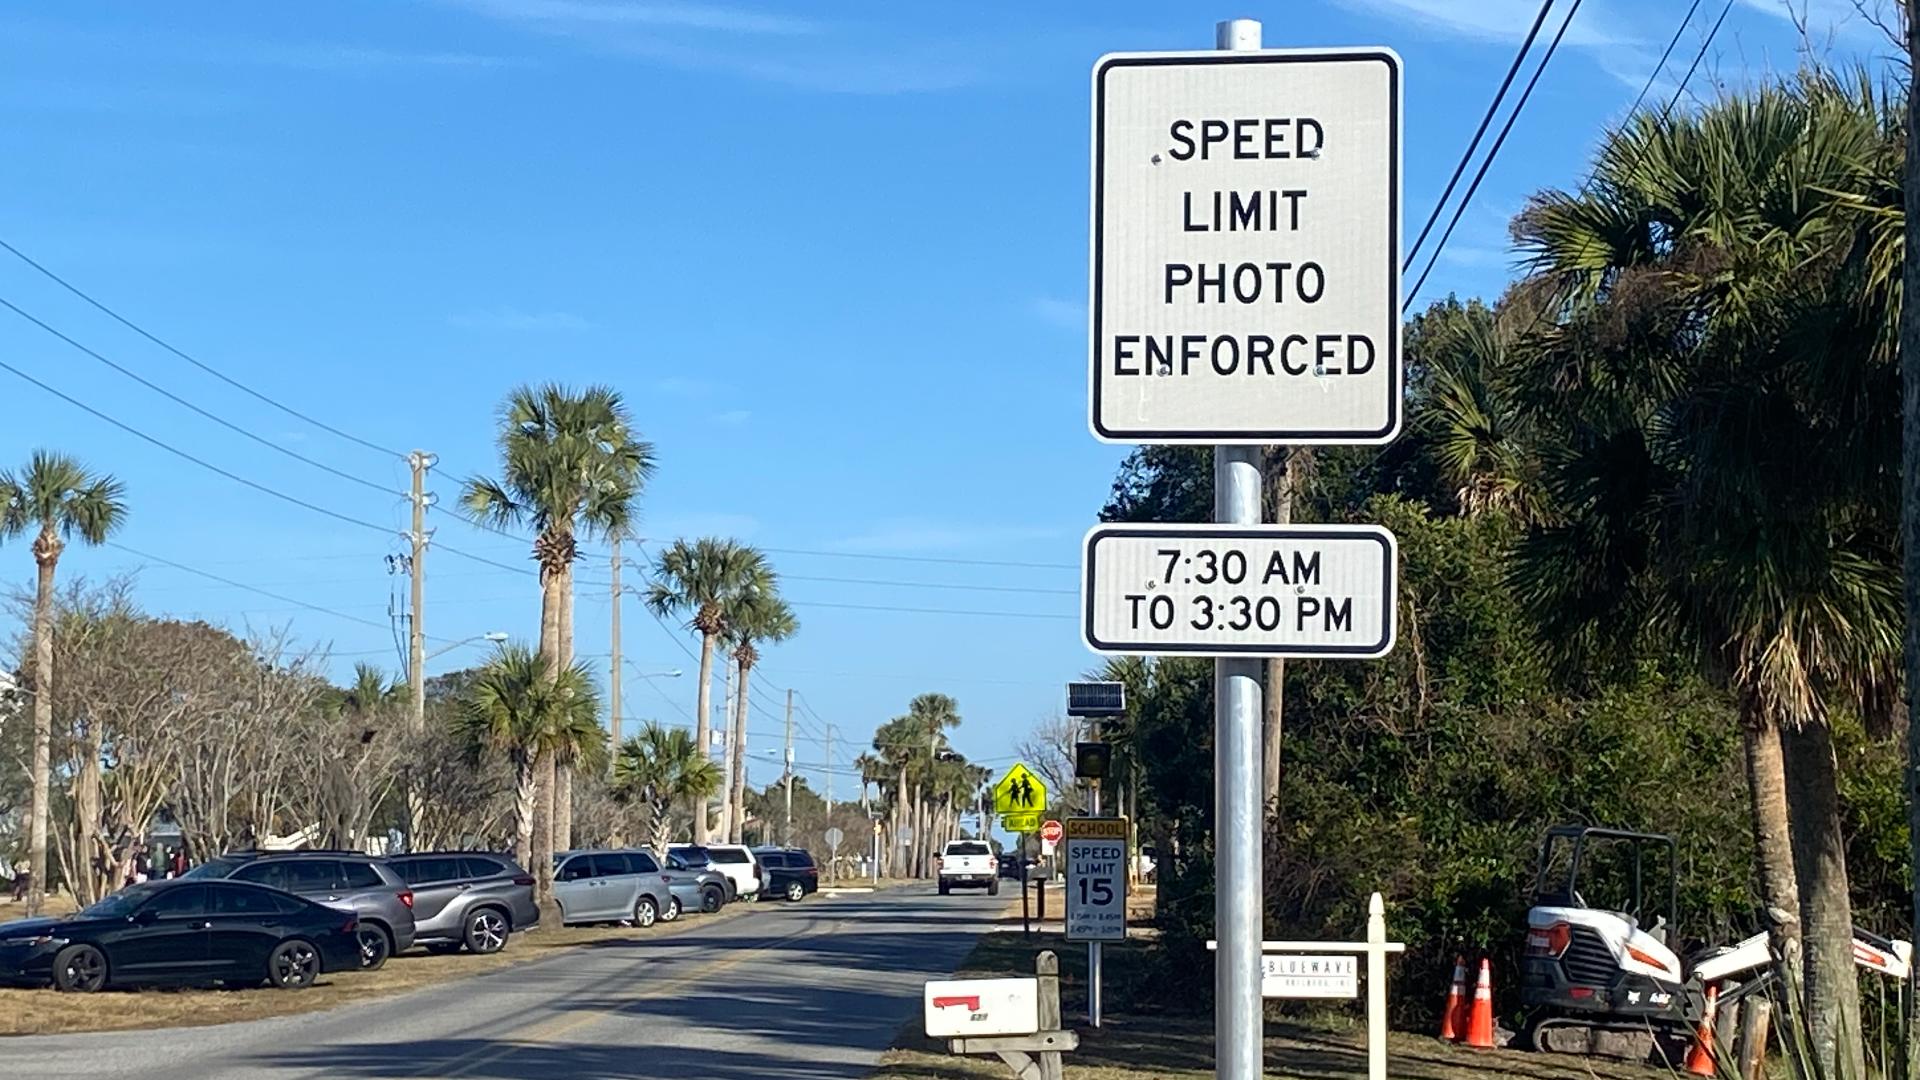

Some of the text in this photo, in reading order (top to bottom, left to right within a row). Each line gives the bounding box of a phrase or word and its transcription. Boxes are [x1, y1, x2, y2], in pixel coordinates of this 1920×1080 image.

[1168, 118, 1324, 161] SPEED
[1183, 190, 1308, 232] LIMIT
[1165, 261, 1326, 304] PHOTO
[1114, 334, 1376, 376] ENFORCED
[1157, 549, 1321, 586] 7:30 AM
[1124, 594, 1352, 632] TO 3:30 PM
[1009, 816, 1036, 828] AHEAD
[1042, 826, 1061, 836] STOP
[1070, 822, 1122, 835] SCHOOL
[1071, 846, 1121, 860] SPEED
[1076, 862, 1116, 875] LIMIT
[1078, 877, 1114, 906] 15
[1268, 960, 1352, 974] BLUEWAVE
